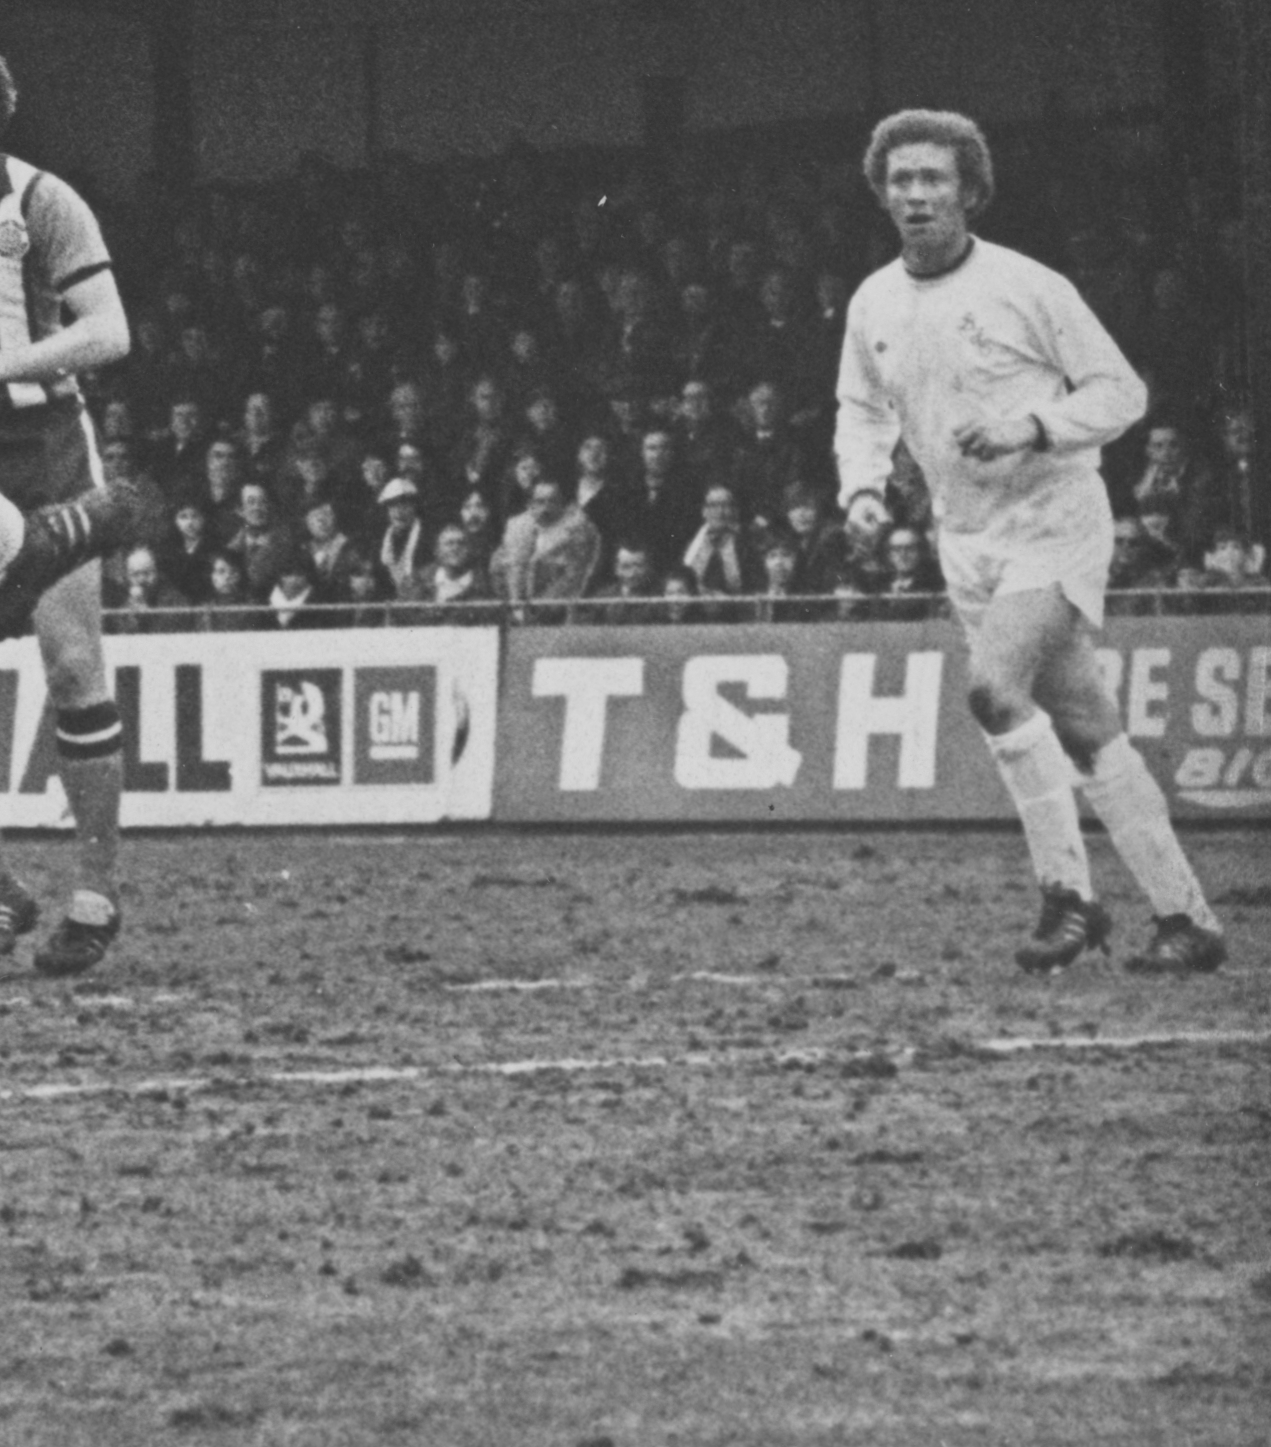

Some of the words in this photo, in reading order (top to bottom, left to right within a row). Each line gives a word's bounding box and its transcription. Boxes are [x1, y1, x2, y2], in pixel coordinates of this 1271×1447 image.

[369, 690, 420, 744] GM
[531, 656, 645, 791] T
[674, 654, 804, 789] &
[832, 652, 944, 790] H
